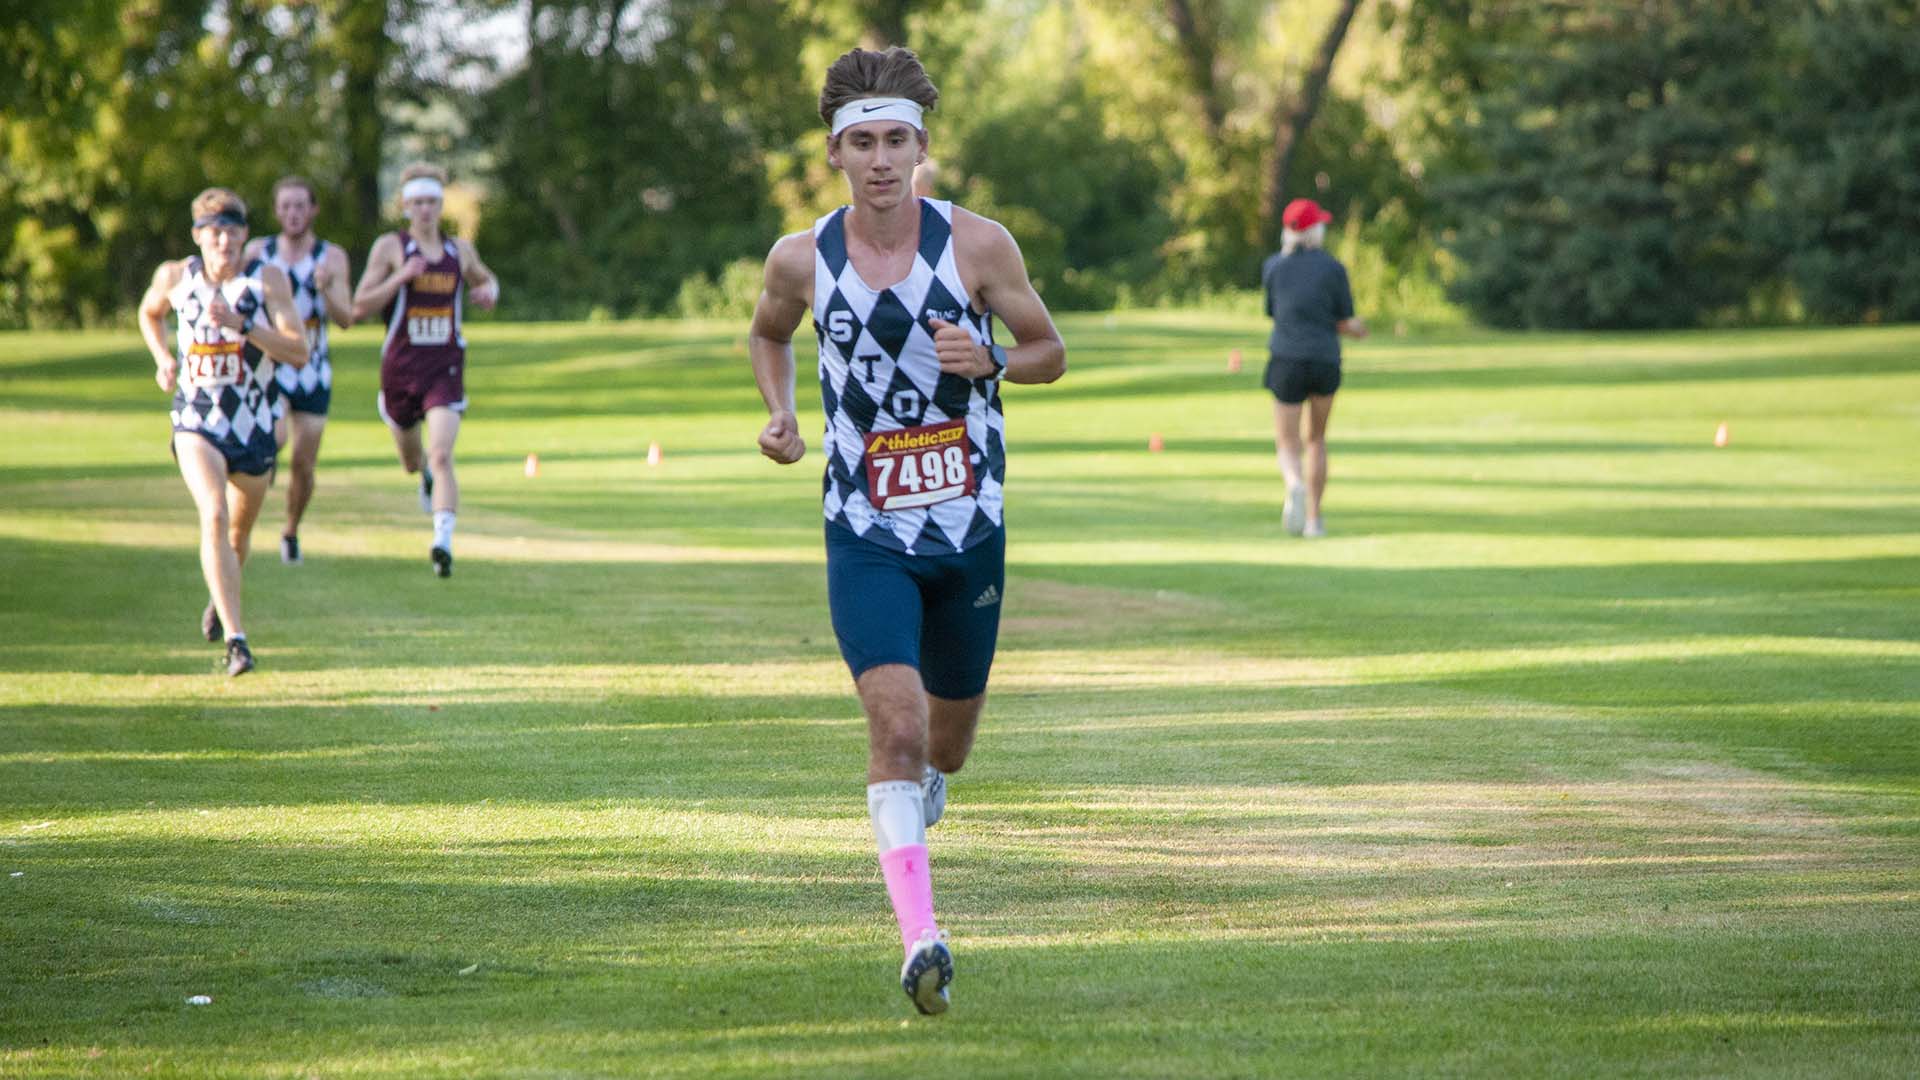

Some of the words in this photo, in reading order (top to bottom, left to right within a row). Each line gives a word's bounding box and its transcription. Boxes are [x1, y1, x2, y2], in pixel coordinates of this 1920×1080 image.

[829, 310, 853, 342] S
[858, 353, 882, 383] T
[892, 389, 920, 419] O
[872, 446, 967, 497] 7498
